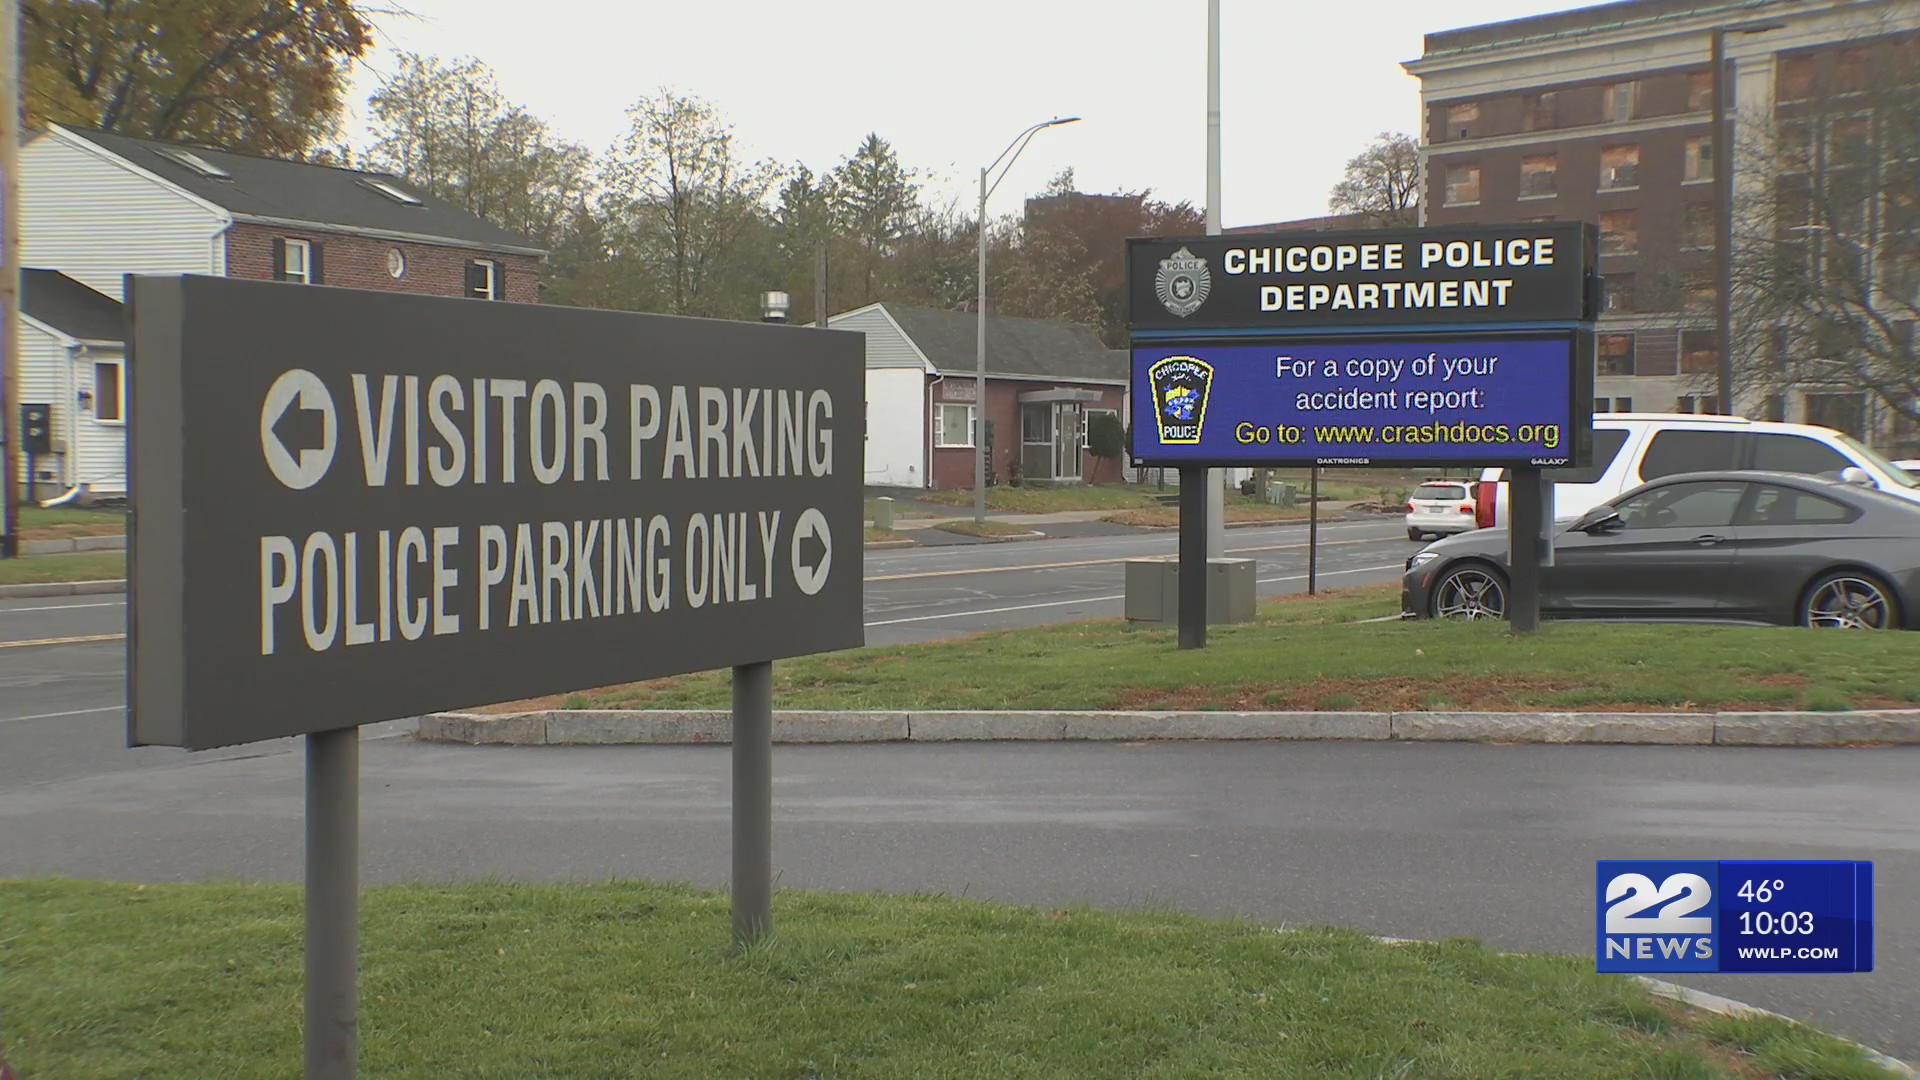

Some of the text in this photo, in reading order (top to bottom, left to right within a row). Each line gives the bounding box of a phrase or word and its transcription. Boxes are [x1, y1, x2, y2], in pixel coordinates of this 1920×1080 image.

[1166, 261, 1199, 270] POLICE
[1223, 238, 1555, 275] CHICOPEE POLICE
[1260, 279, 1514, 312] DEPARTMENT
[1276, 354, 1499, 384] For a copy of your
[1295, 386, 1485, 415] accident report:
[351, 373, 834, 488] VISITOR PARKING
[1164, 425, 1198, 438] POLICE
[1235, 420, 1560, 448] Go to: www.crashdocs.org
[260, 510, 782, 657] POLICE PARKING ONLY
